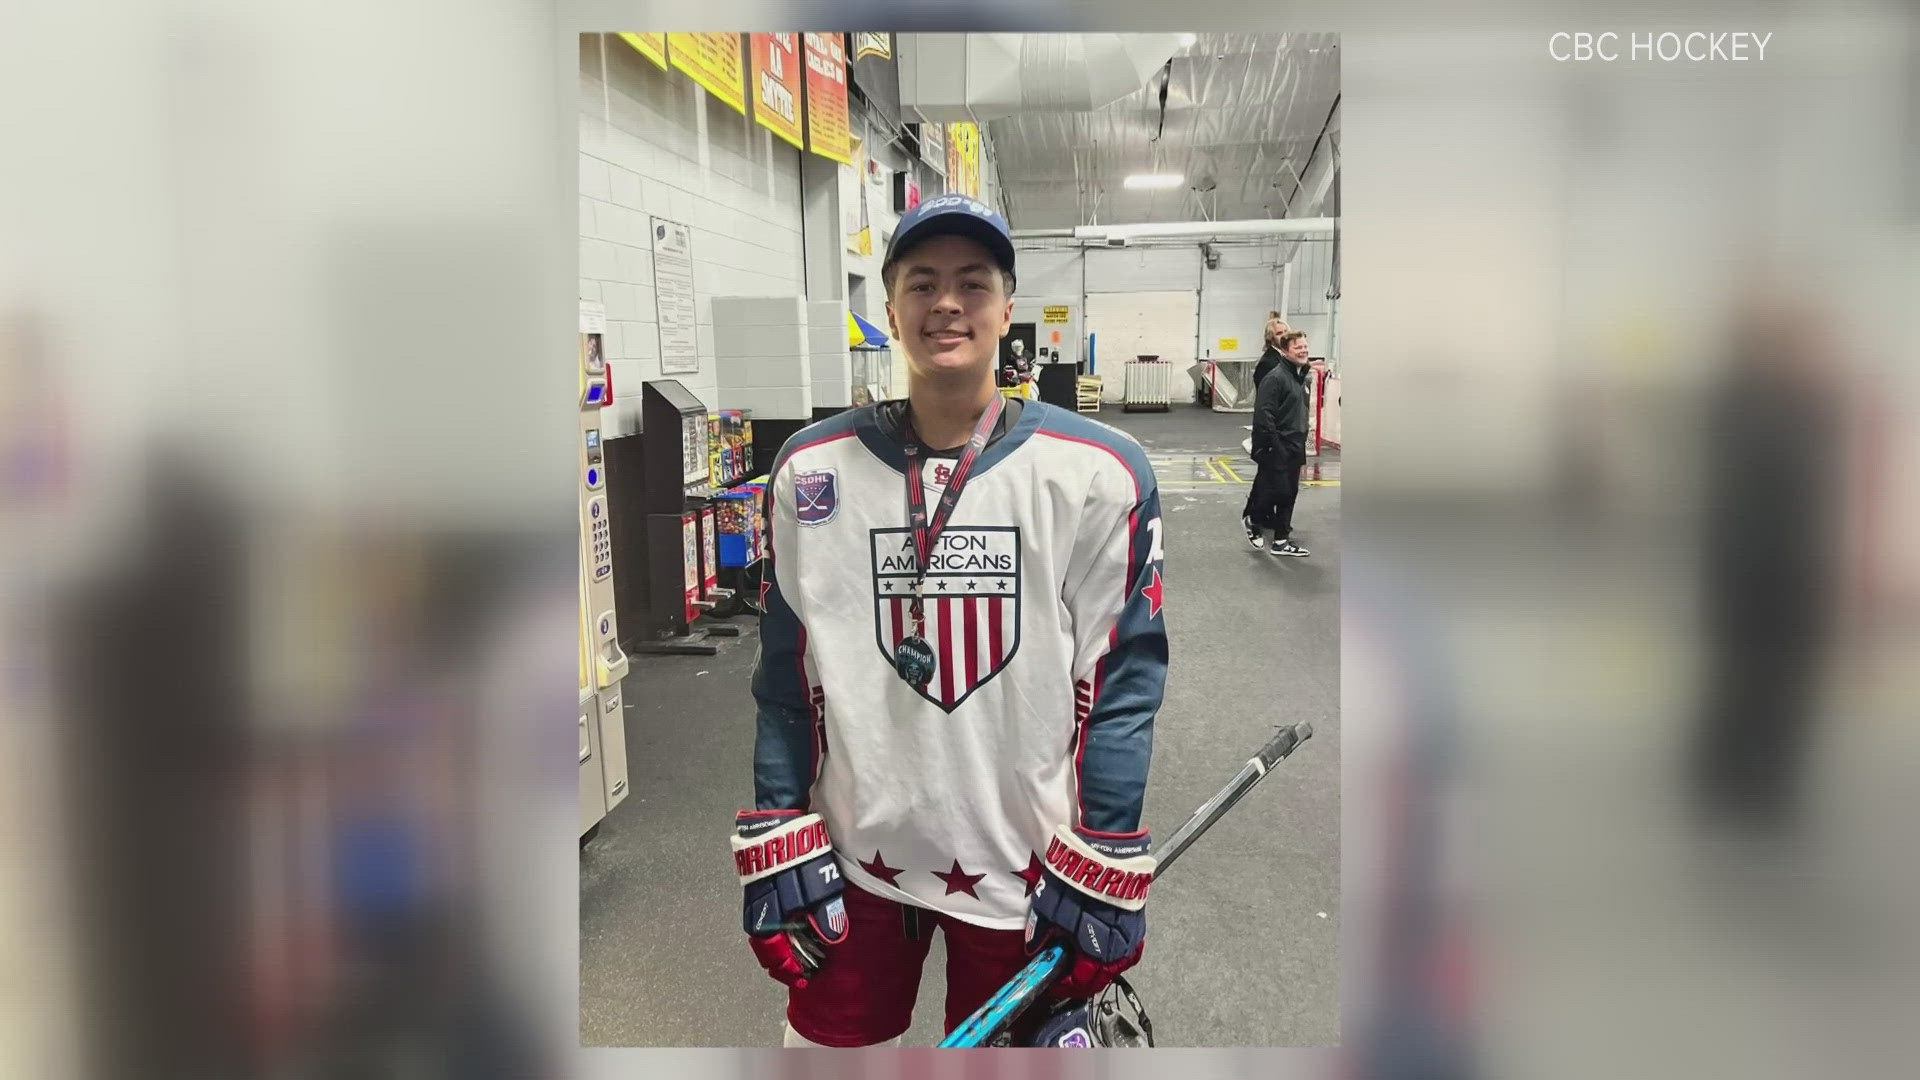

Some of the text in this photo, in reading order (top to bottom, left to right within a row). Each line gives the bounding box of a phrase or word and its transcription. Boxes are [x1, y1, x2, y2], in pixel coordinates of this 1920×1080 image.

[794, 475, 829, 485] CSDHL
[901, 535, 986, 552] ATON
[881, 554, 1012, 571] AMRICANS
[898, 645, 931, 664] CHAMPION
[818, 862, 840, 885] 72
